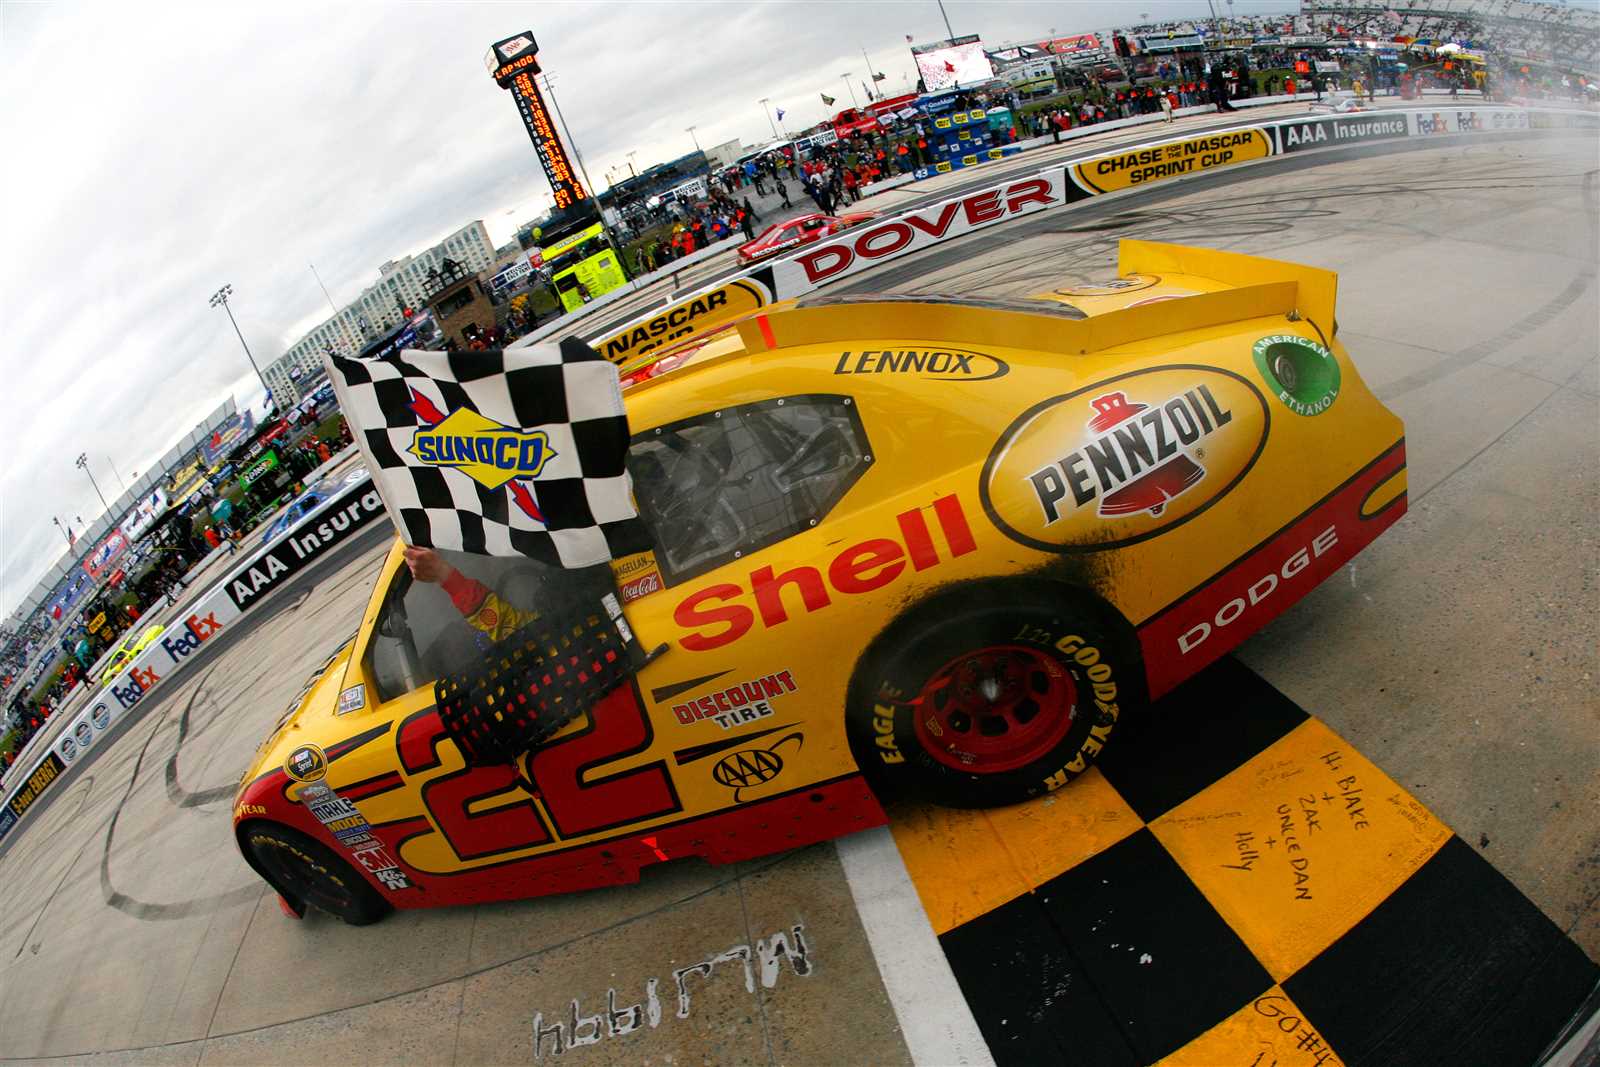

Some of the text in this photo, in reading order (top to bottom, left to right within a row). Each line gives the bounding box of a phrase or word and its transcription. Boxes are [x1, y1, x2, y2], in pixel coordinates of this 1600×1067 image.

[495, 64, 513, 79] LAP
[514, 55, 534, 68] 400
[1287, 117, 1404, 147] AAA Insurance
[1416, 112, 1448, 135] FedEx
[1457, 111, 1484, 131] FedEx
[1097, 144, 1181, 175] CHASE FOR
[1168, 132, 1252, 158] THE NASCAR
[914, 168, 929, 179] 43
[1130, 150, 1233, 184] SPRINT CUP
[793, 178, 1064, 285] DOVER
[607, 289, 728, 359] NASCAR
[833, 350, 978, 375] LENNOX
[1253, 335, 1330, 359] AMERICAN
[1279, 388, 1338, 416] ETHANOL
[418, 435, 544, 471] SUNOCO
[1029, 383, 1233, 527] PENNZOIL
[233, 559, 289, 605] AAA
[673, 492, 978, 653] Shell
[1177, 524, 1339, 656] DODGE
[162, 611, 223, 664] FedEx
[111, 665, 161, 710] FedEx
[672, 670, 798, 725] DISCOUNT
[715, 702, 772, 728] TIRE
[28, 757, 59, 795] ENERGY
[719, 750, 779, 788] AAA
[312, 797, 357, 821] MAHLE
[327, 815, 365, 833] MOOG
[1220, 831, 1260, 872] Holly
[1276, 803, 1301, 854] UNCLE
[1290, 858, 1313, 901] DAN
[1254, 995, 1301, 1033] GO
